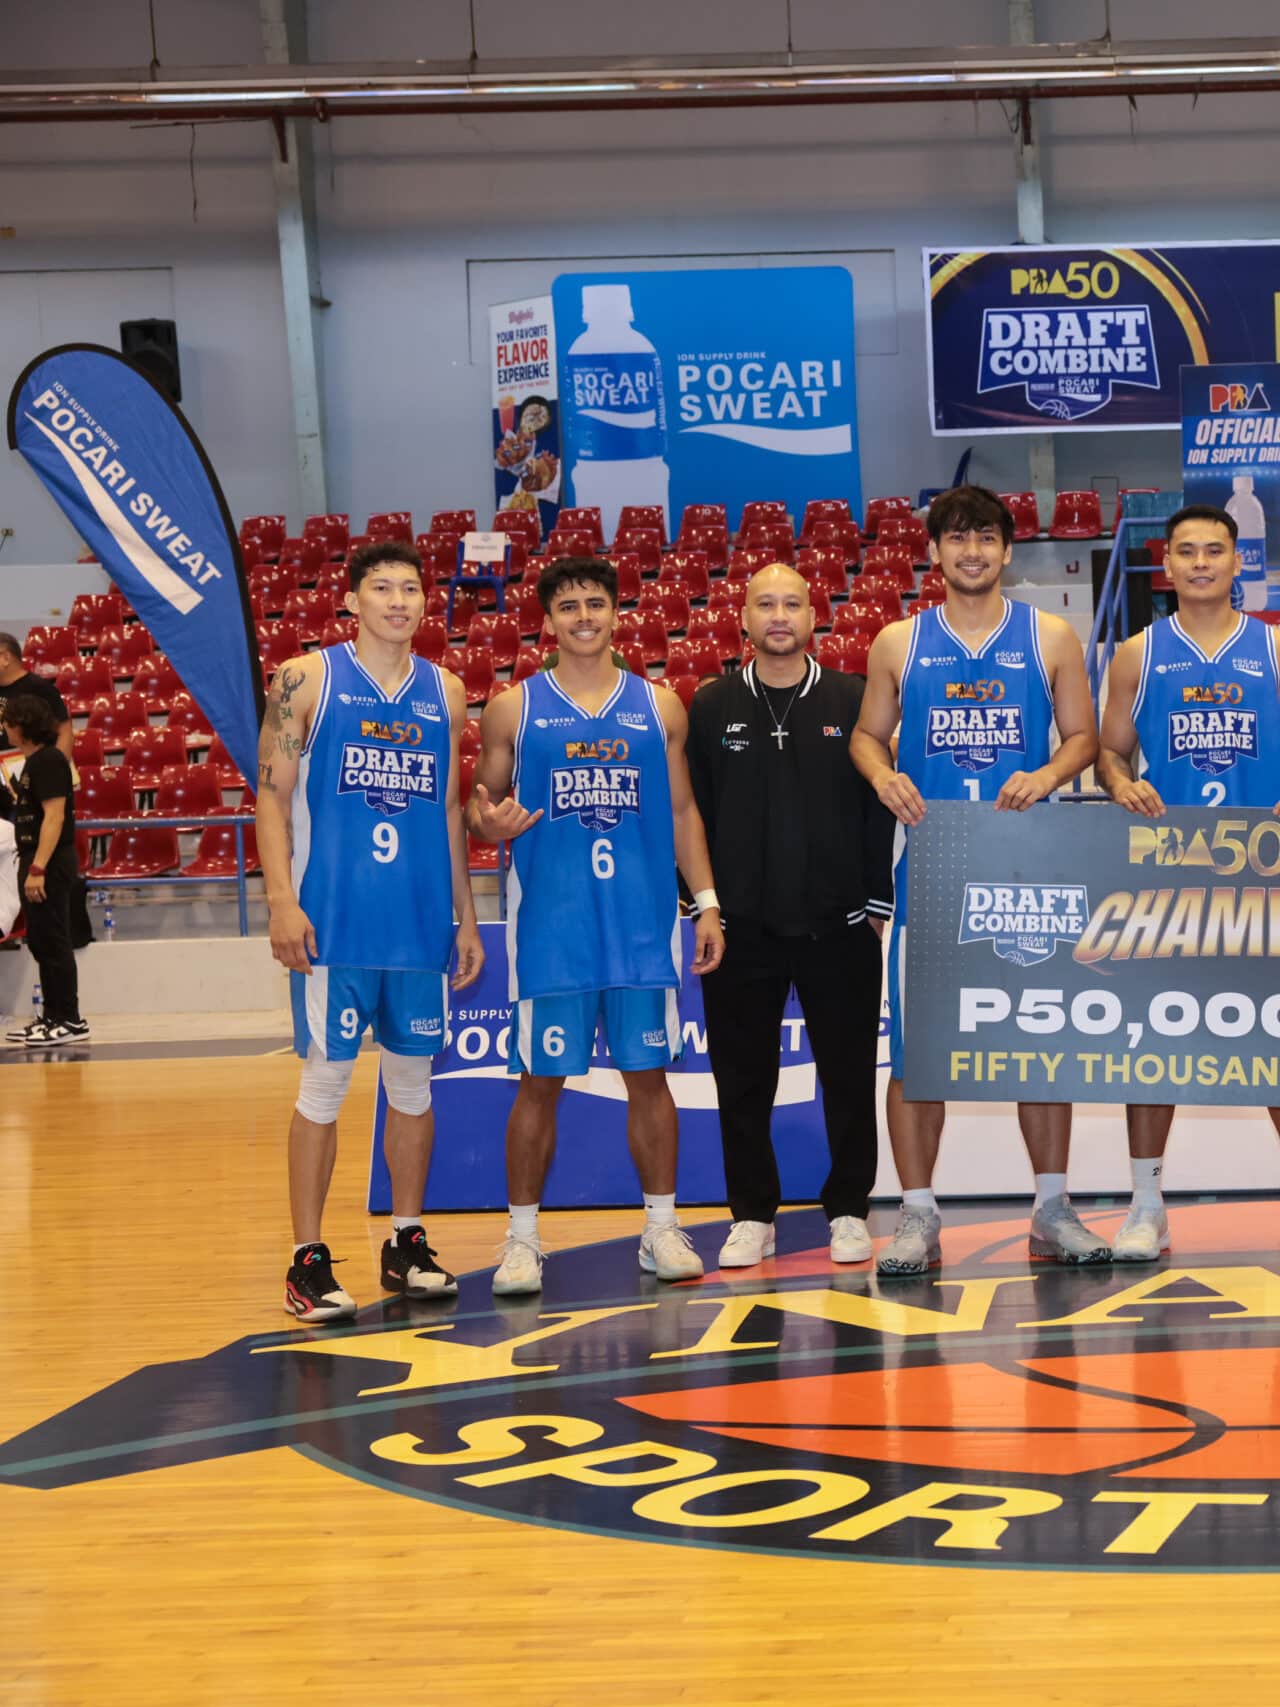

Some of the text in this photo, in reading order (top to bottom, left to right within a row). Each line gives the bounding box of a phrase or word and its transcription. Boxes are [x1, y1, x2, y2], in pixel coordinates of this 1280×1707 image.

[1011, 261, 1120, 300] PBA50
[497, 325, 548, 342] YOUR FAVORITE
[988, 311, 1146, 349] DRAFT
[497, 338, 548, 367] FLAVOR
[678, 353, 695, 361] ION
[736, 352, 766, 360] DRINK
[990, 347, 1147, 375] COMBINE
[498, 362, 549, 384] EXPERIENCE
[573, 372, 653, 390] POCARI
[678, 359, 841, 392] POCARI
[575, 387, 649, 406] SWEAT
[680, 390, 827, 422] SWEAT
[1209, 382, 1271, 413] PBA
[68, 397, 98, 431] SUPPLY
[95, 425, 120, 453] DRINK
[1187, 449, 1208, 465] ION
[1211, 448, 1256, 464] SUPPLY
[32, 388, 222, 585] POCARI SWEAT
[931, 708, 1020, 730] DRAFT
[1171, 710, 1256, 735] DRAFT
[932, 729, 1020, 747] COMBINE
[1175, 733, 1253, 751] COMBINE
[345, 746, 434, 776] DRAFT
[345, 770, 433, 793] COMBINE
[554, 768, 640, 793] DRAFT
[963, 779, 980, 802] 1
[1201, 781, 1226, 807] 2
[372, 821, 399, 864] 9
[591, 838, 615, 879] 6
[968, 887, 1083, 914] DRAFT
[968, 913, 1083, 933] COMBINE
[340, 1008, 359, 1040] 9
[542, 1025, 566, 1057] 6
[950, 1051, 1064, 1082] FIFTY
